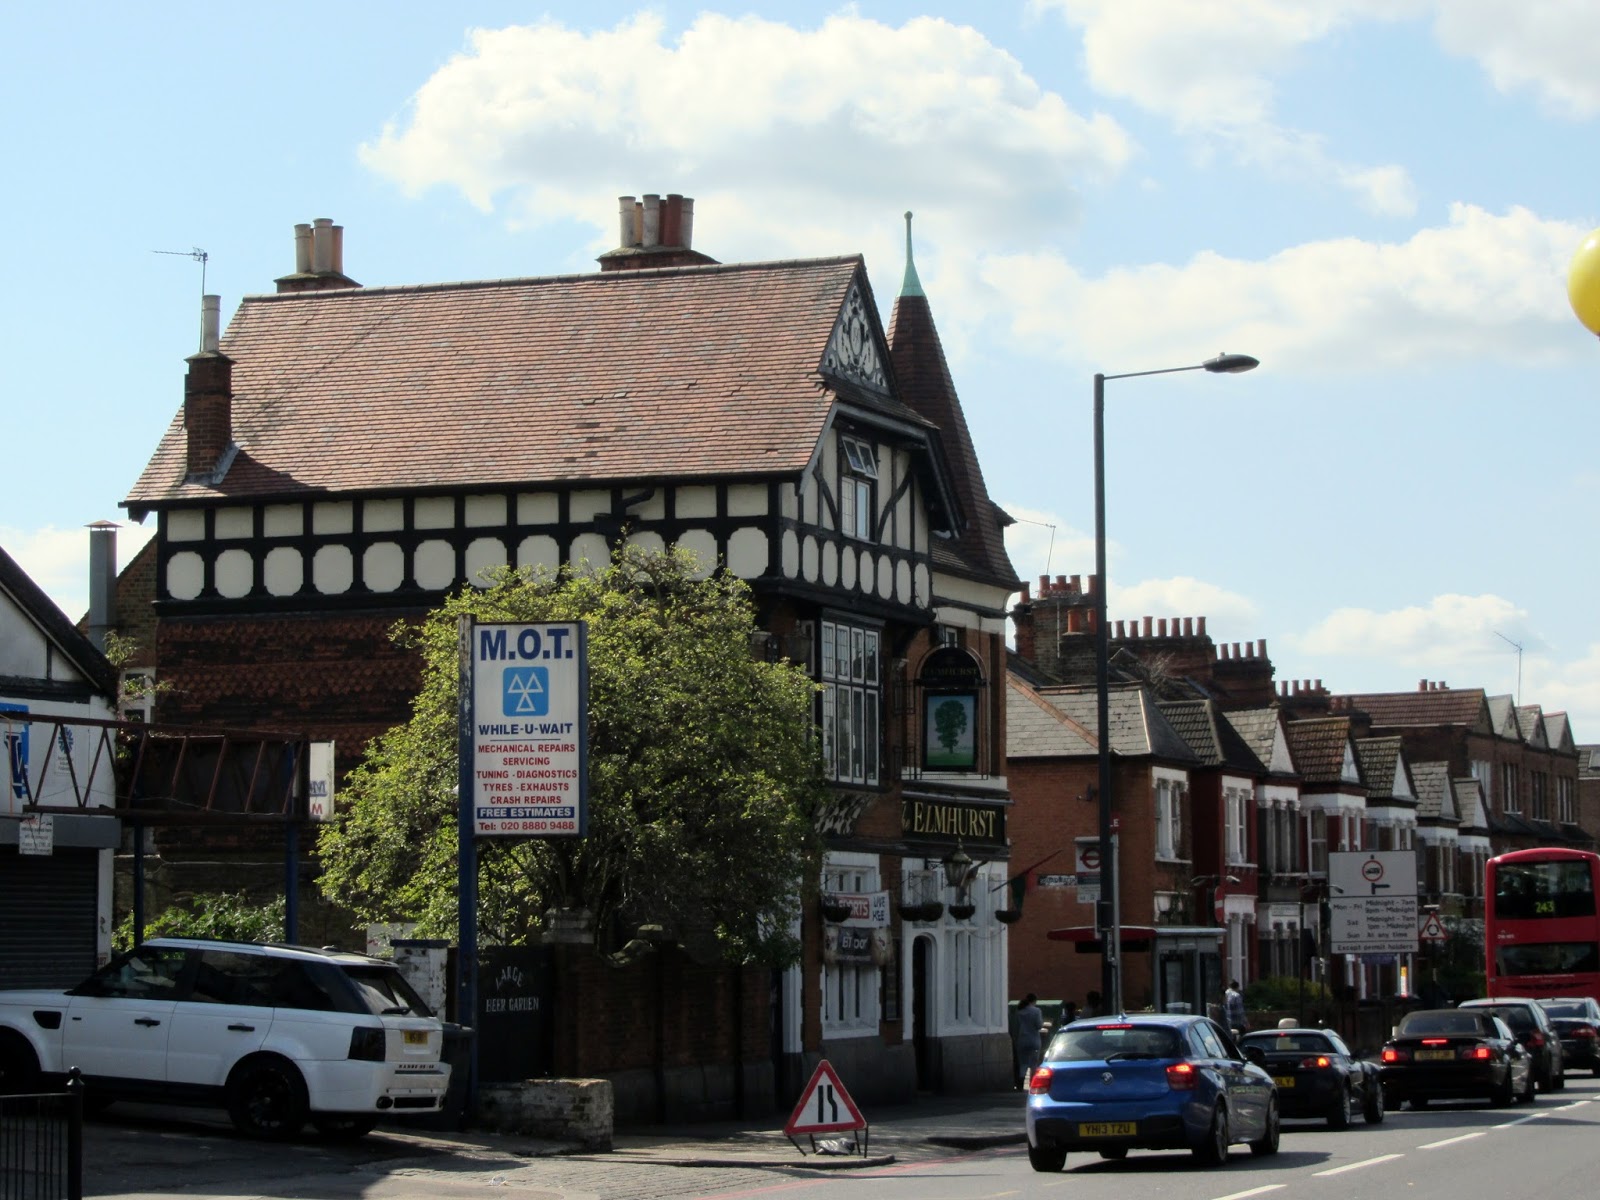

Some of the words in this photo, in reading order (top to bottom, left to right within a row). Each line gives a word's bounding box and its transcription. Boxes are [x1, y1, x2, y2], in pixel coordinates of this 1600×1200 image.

[480, 628, 573, 661] M.O.T.
[478, 723, 573, 735] WHILE-U-WAIT
[478, 744, 535, 753] MECHANICAL
[538, 744, 576, 753] REPAIRS
[502, 757, 550, 766] SERVICING
[476, 770, 509, 779] TUNING
[483, 783, 513, 791] TYRES
[490, 796, 521, 804] CRASH
[524, 795, 562, 804] REPAIRS
[480, 808, 507, 817] FREE
[511, 807, 571, 817] ESTIMATES
[914, 801, 996, 838] ELMHURST
[479, 822, 496, 831] Tel:
[501, 821, 519, 830] 020
[522, 821, 547, 830] 8880
[550, 821, 575, 830] 9488
[1535, 901, 1555, 913] 243
[486, 998, 506, 1013] BEER
[509, 996, 539, 1011] GARDEN
[1085, 1124, 1108, 1134] YH13
[1111, 1122, 1130, 1133] TZU
